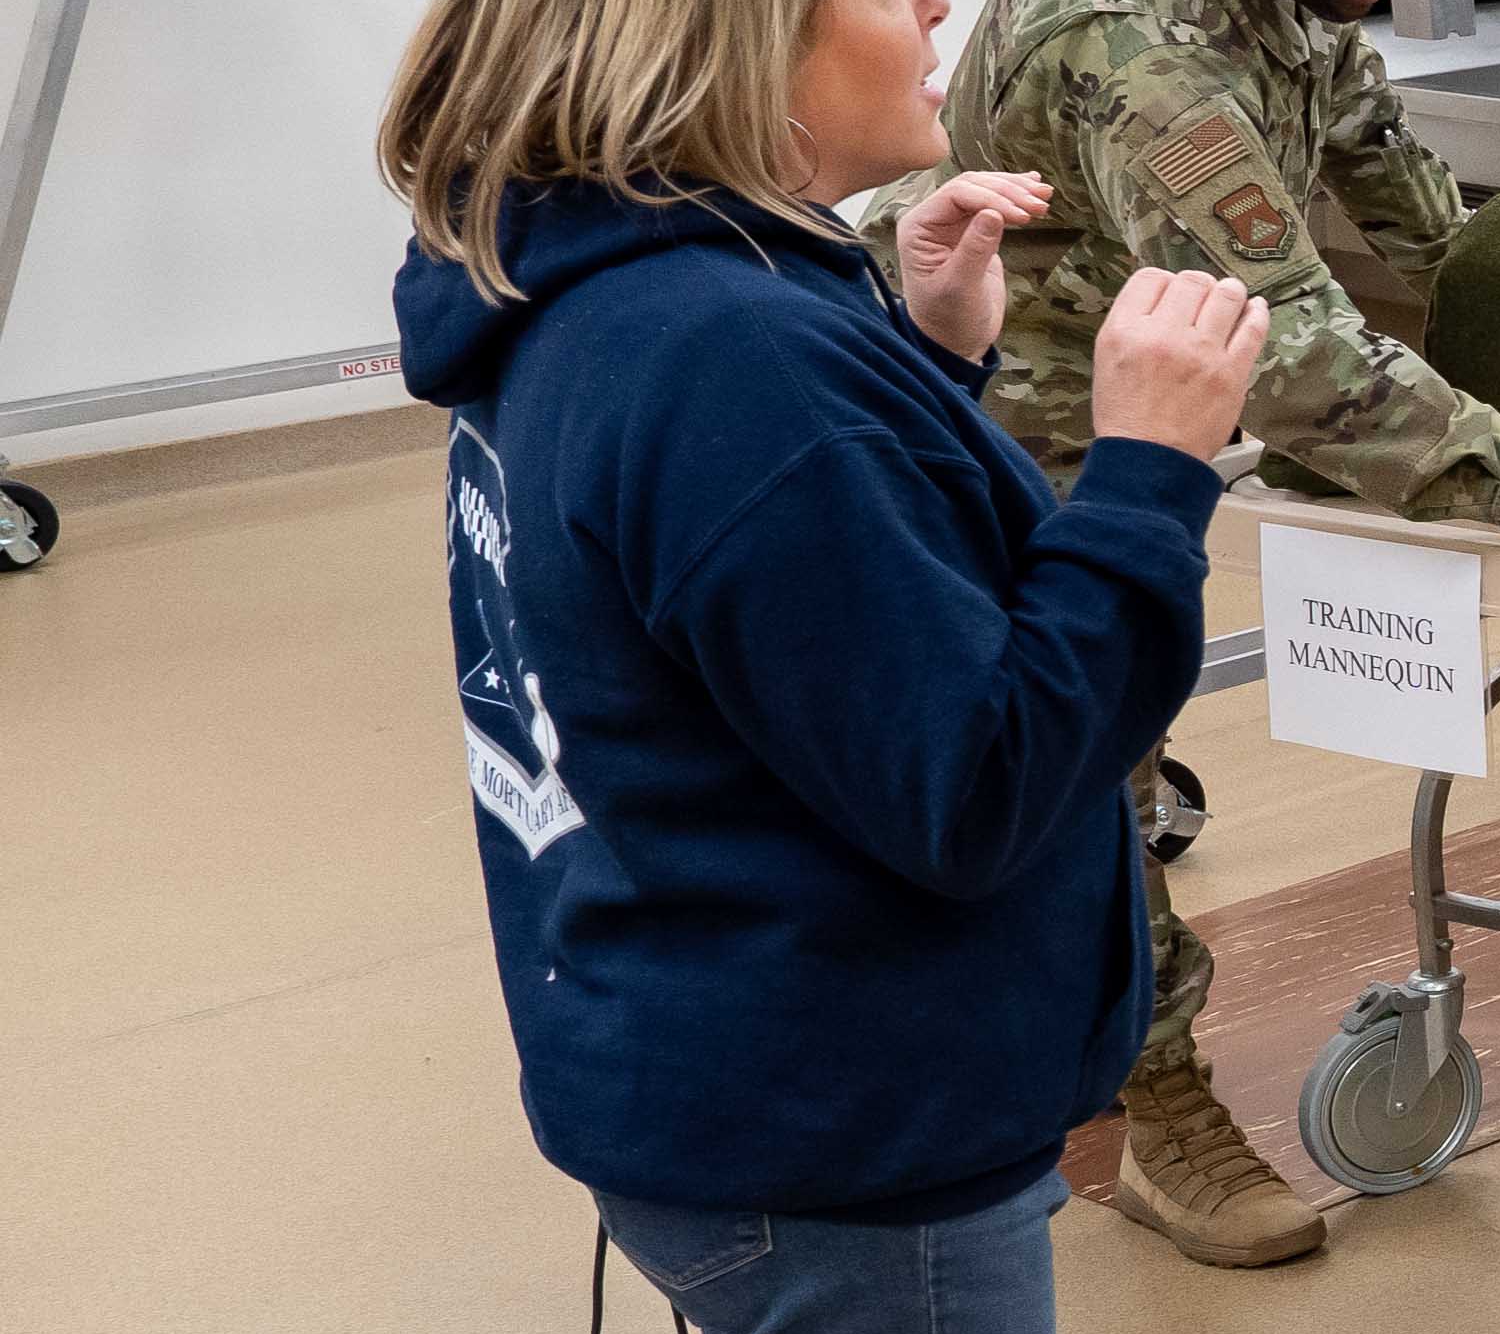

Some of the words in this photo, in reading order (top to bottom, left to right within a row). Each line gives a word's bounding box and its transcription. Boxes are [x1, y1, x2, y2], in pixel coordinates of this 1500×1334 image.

[343, 362, 366, 376] NO
[370, 357, 400, 372] STE
[1302, 599, 1434, 645] TRAINING
[1288, 639, 1454, 694] MANNEQUIN
[481, 760, 557, 835] MORTUARY
